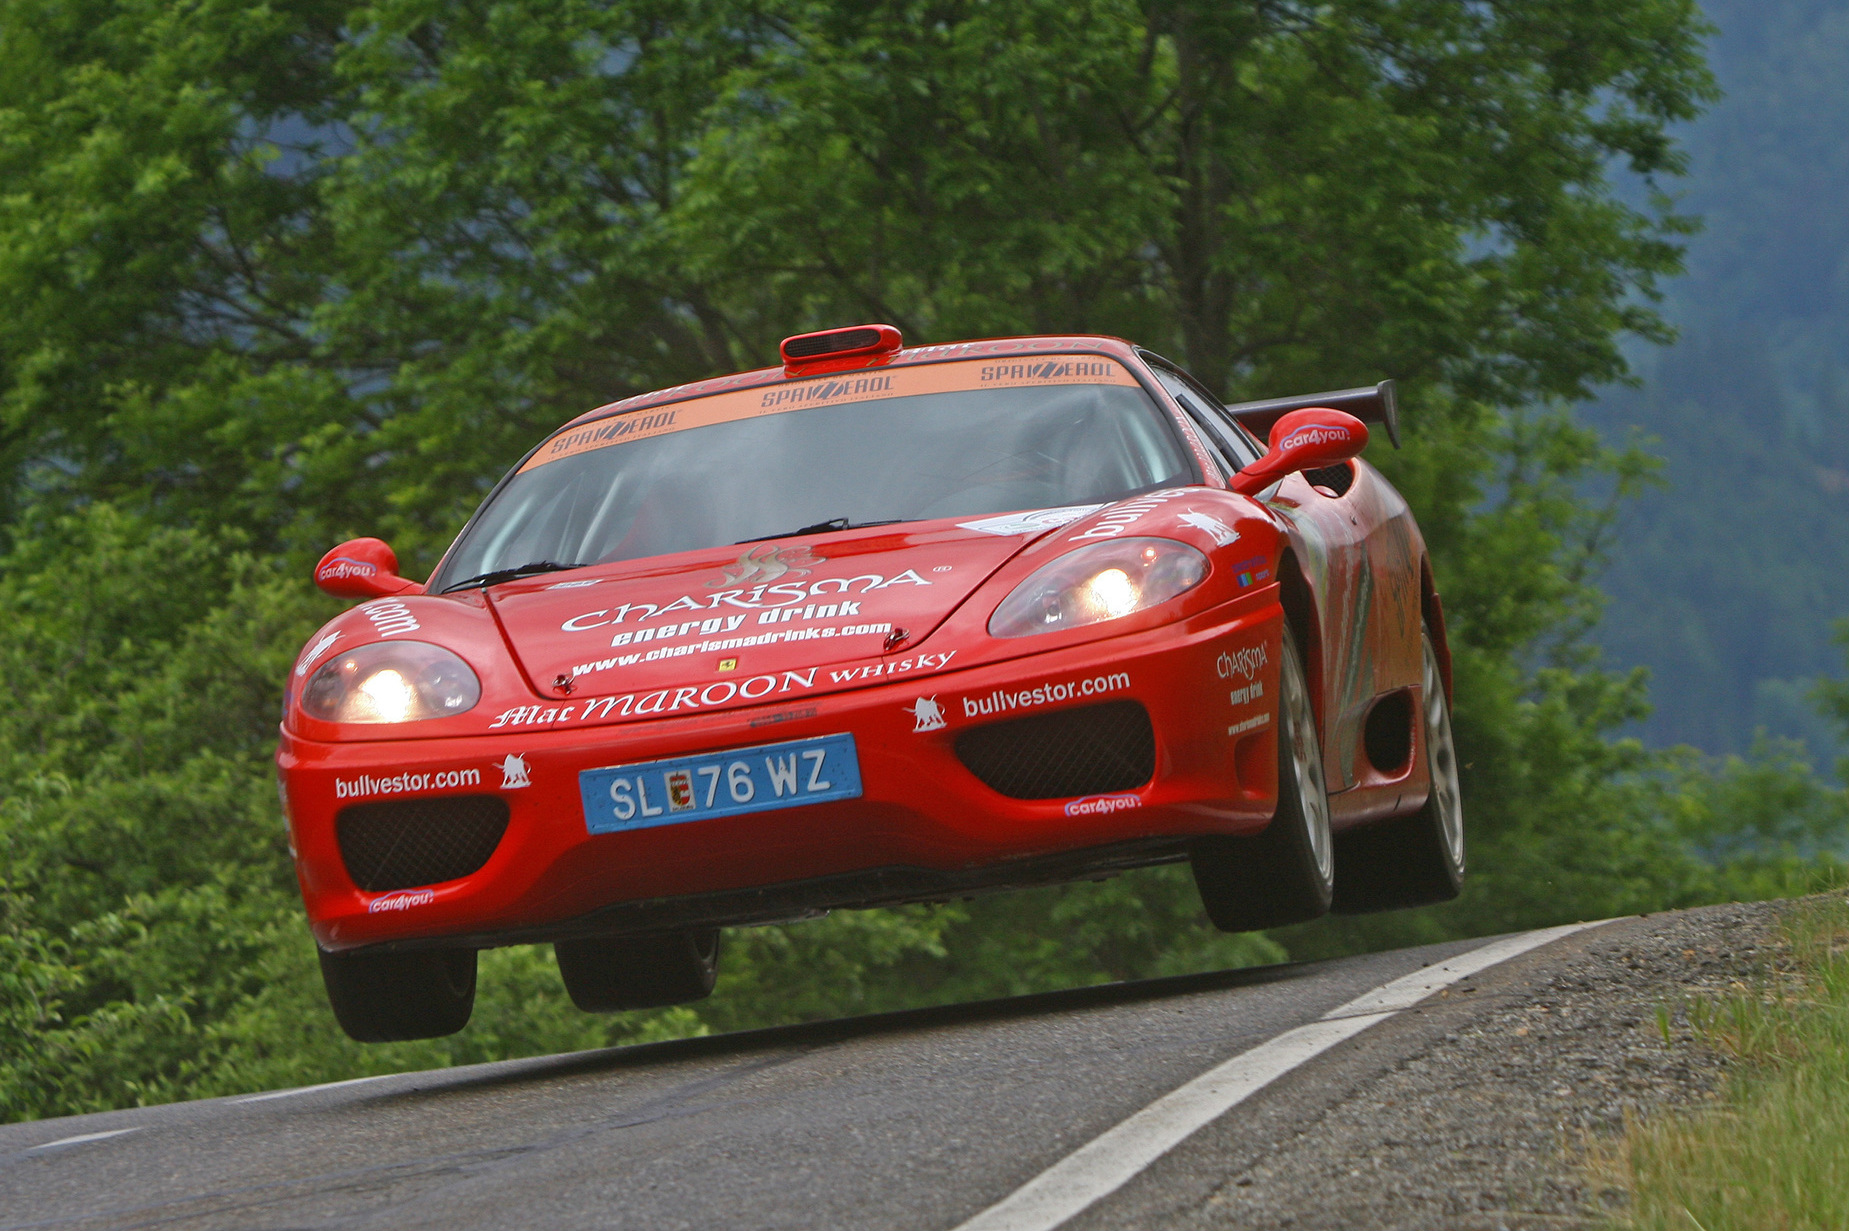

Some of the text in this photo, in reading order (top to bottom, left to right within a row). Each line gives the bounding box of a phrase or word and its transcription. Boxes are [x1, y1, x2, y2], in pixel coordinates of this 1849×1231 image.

[611, 600, 861, 648] energy drink
[572, 622, 892, 677] www.charismadrinks.com
[488, 704, 576, 729] Mac
[963, 672, 1131, 718] bullvestor.com
[335, 768, 481, 799] bullvestor.com
[609, 749, 832, 821] SL 76 WZ
